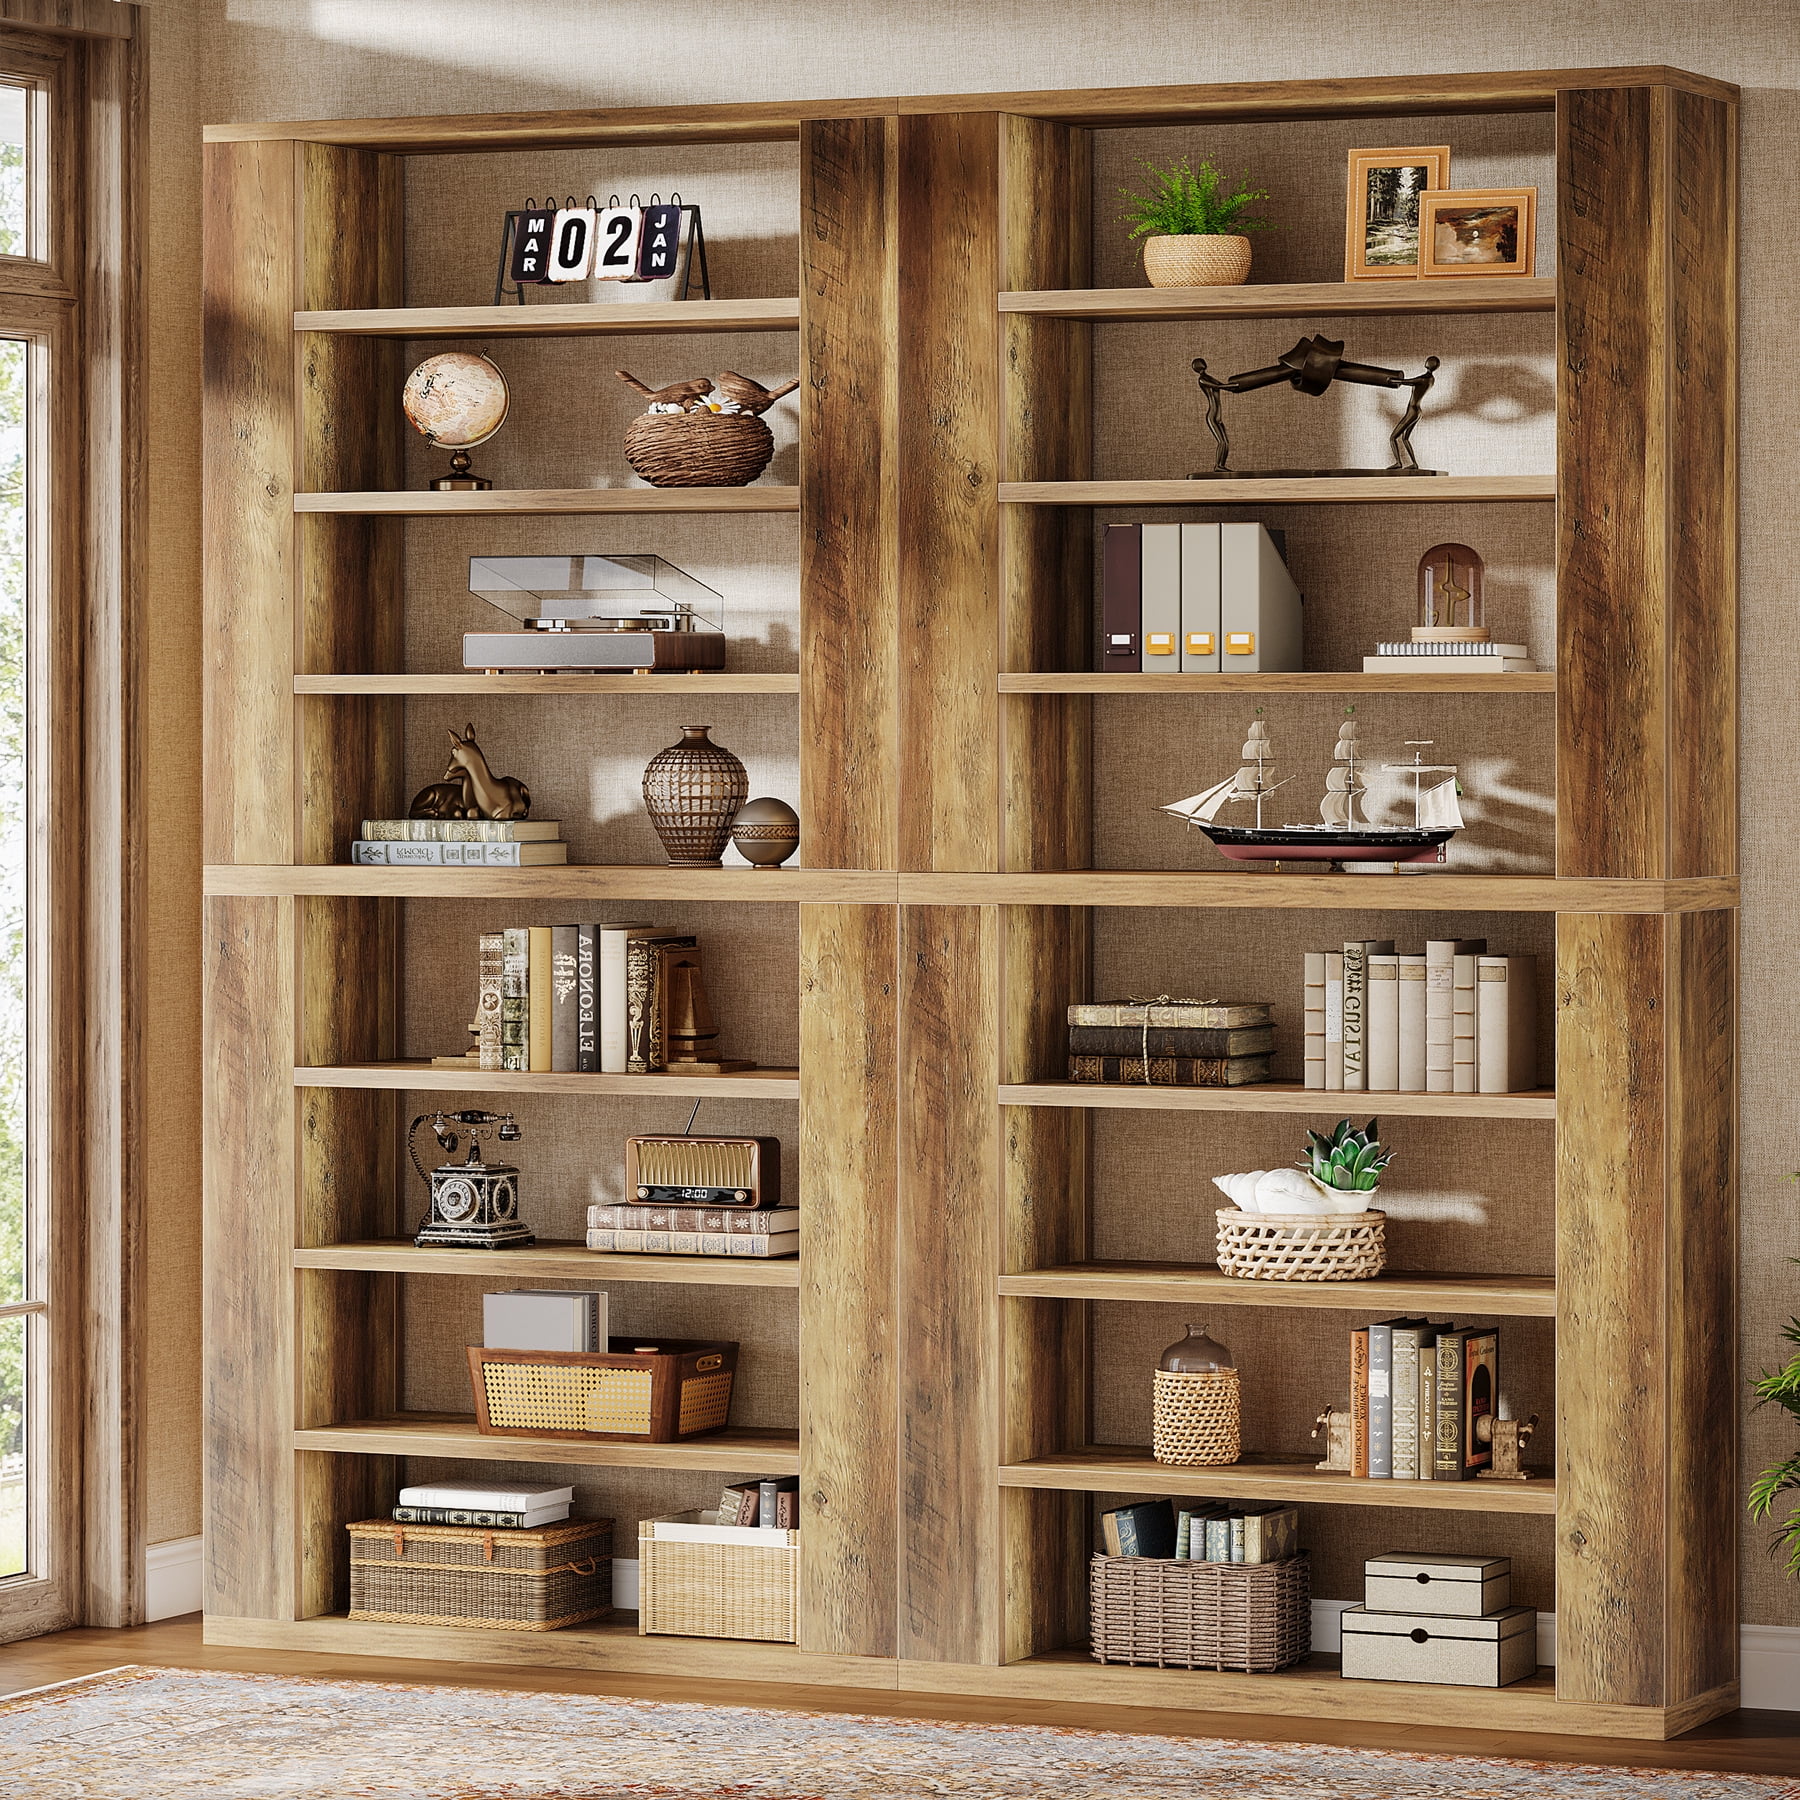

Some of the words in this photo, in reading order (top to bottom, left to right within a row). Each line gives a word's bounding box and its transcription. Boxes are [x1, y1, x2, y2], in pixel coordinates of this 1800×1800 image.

[523, 218, 545, 272] MAR
[651, 214, 667, 268] JAN
[681, 1188, 708, 1199] 12:00
